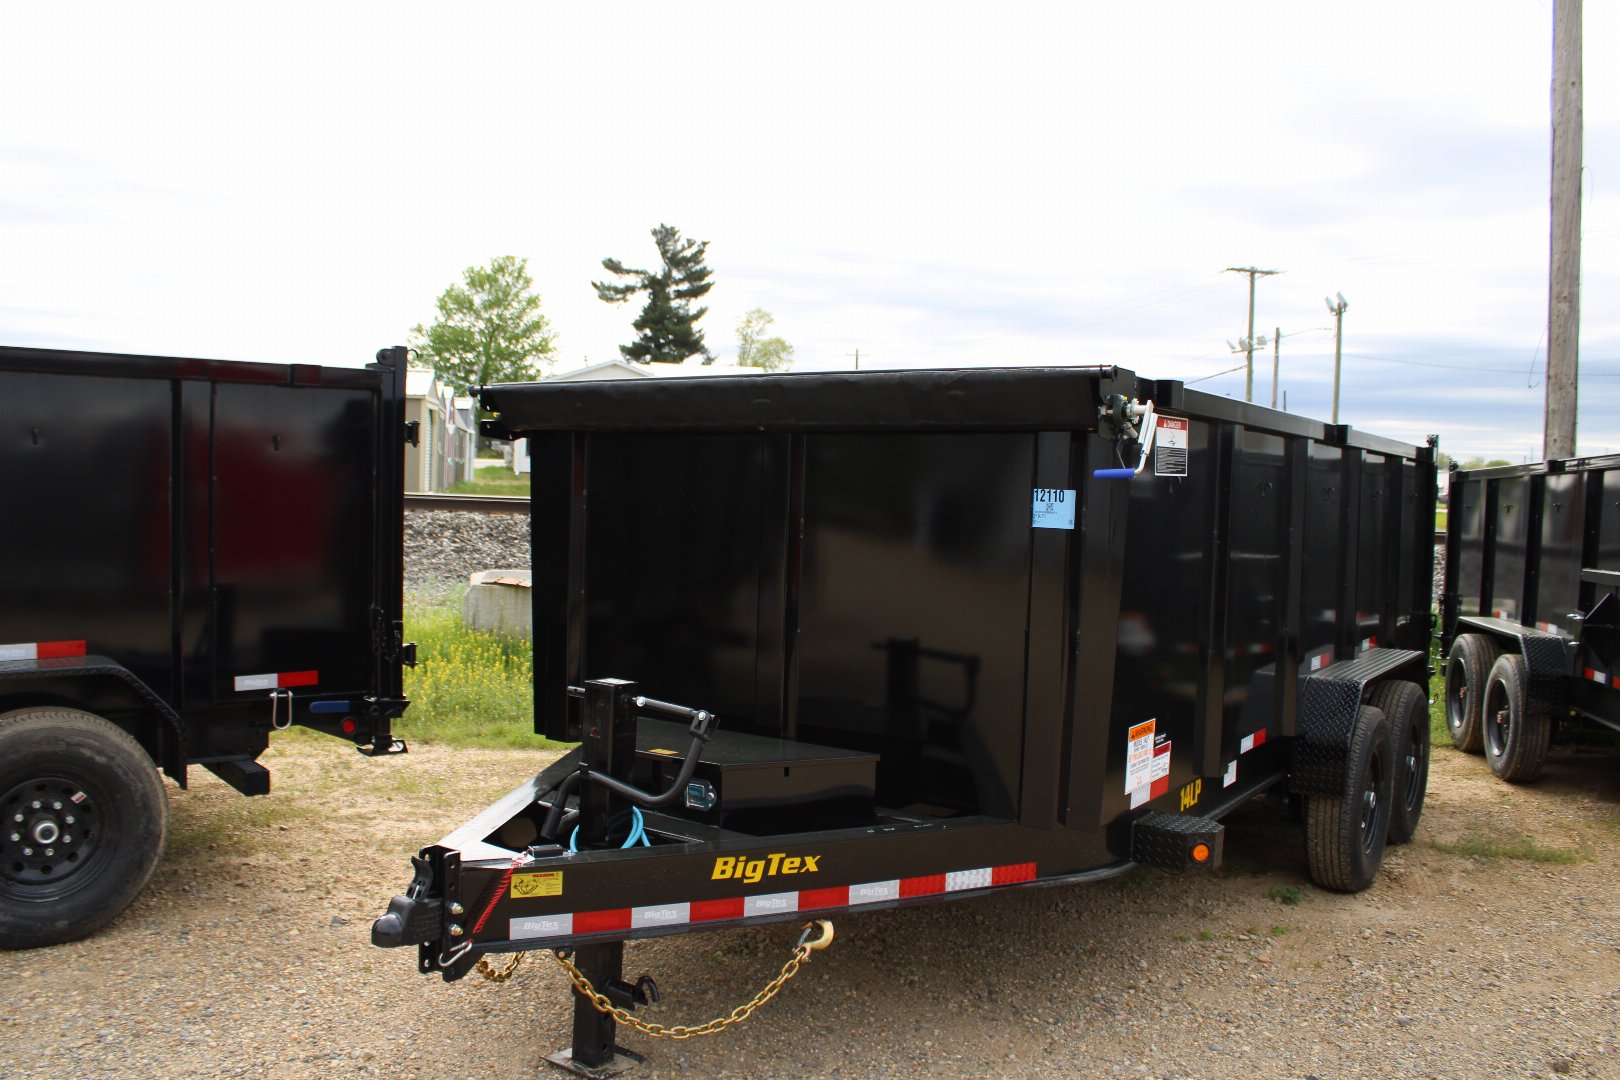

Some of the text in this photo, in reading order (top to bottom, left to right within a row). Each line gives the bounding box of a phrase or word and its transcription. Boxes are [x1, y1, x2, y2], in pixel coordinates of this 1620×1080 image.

[1034, 489, 1065, 503] 12110
[1180, 778, 1202, 812] 14LP
[711, 852, 822, 884] BigTex
[643, 909, 677, 919] BigTex
[522, 920, 559, 931] BigTex
